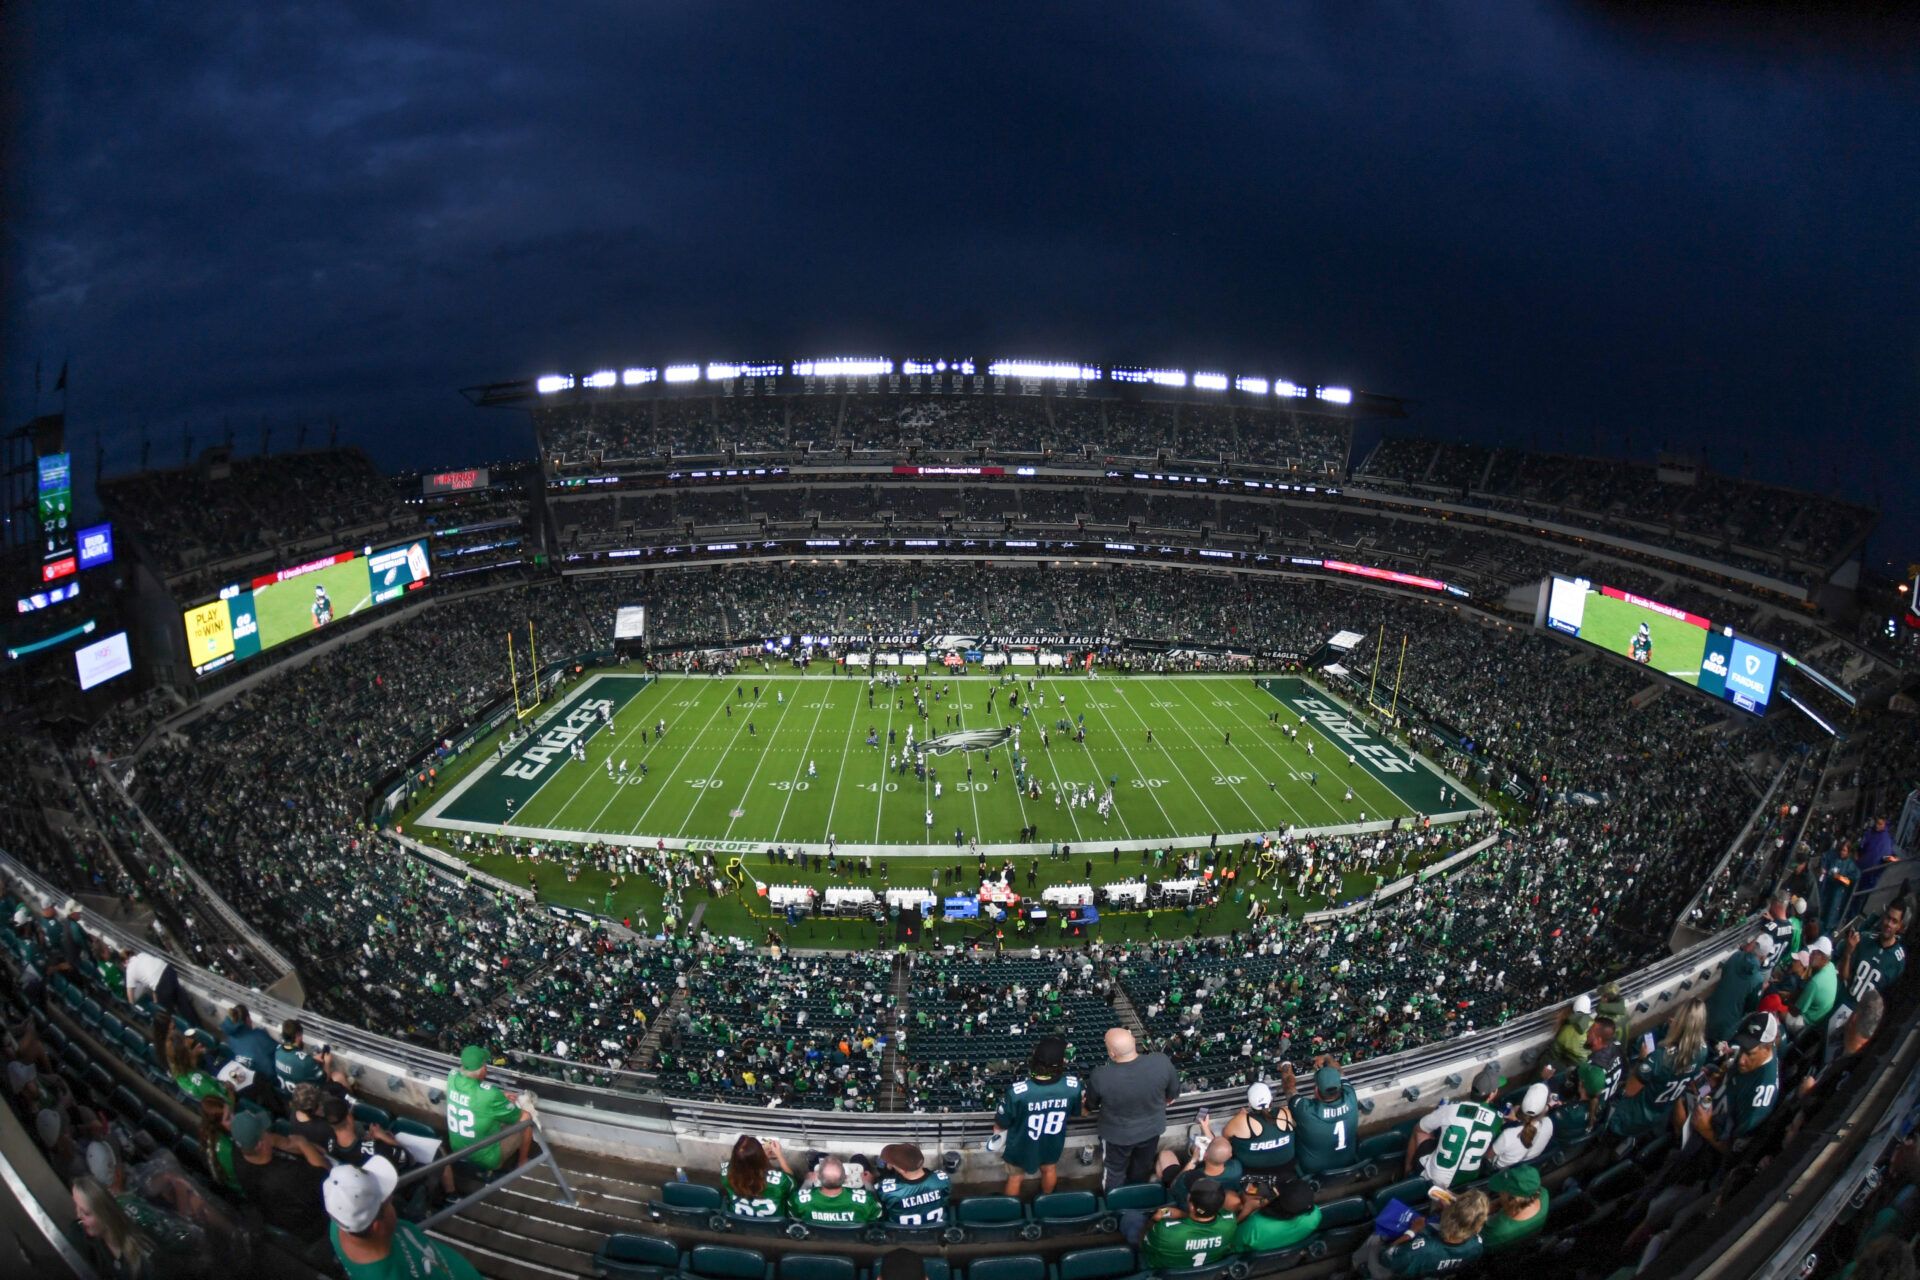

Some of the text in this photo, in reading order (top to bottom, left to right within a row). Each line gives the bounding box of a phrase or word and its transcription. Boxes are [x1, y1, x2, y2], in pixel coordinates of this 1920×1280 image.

[84, 534, 105, 548] BUD
[82, 543, 108, 560] LIGHT
[283, 556, 335, 579] Lincoln Financial Field
[196, 608, 218, 625] PLAY
[1630, 596, 1686, 621] Lincoln Financial Field
[203, 616, 224, 637] WIN!
[236, 613, 251, 627] GO
[800, 635, 918, 644] PILDELPHI EAGLES
[991, 636, 1111, 644] PHILADELPHIA EAGLES
[1272, 652, 1298, 660] EAGLES
[1709, 652, 1725, 666] GO
[1731, 672, 1766, 695] FANDUEL
[501, 698, 614, 780] EAGLES
[1292, 699, 1416, 772] EAGLES
[691, 779, 724, 789] 20
[776, 782, 810, 791] 30
[864, 782, 898, 792] 40
[956, 782, 988, 792] 50
[1046, 782, 1078, 791] 40
[1131, 778, 1162, 788] 30
[1212, 776, 1242, 785] 20
[684, 841, 760, 852] KICKOFF
[1851, 960, 1882, 1002] 86
[1655, 1077, 1691, 1103] 26
[1752, 1084, 1776, 1107] 20
[1028, 1098, 1068, 1112] CARTER
[446, 1103, 475, 1138] 62
[1028, 1111, 1066, 1140] 98
[1250, 1135, 1290, 1151] EAGLES
[1333, 1120, 1346, 1151] 1
[1436, 1124, 1493, 1171] 92
[902, 1190, 941, 1209] KEARSE
[812, 1210, 854, 1222] BARKLEY
[1185, 1236, 1222, 1251] HURTS
[1192, 1252, 1207, 1268] 1
